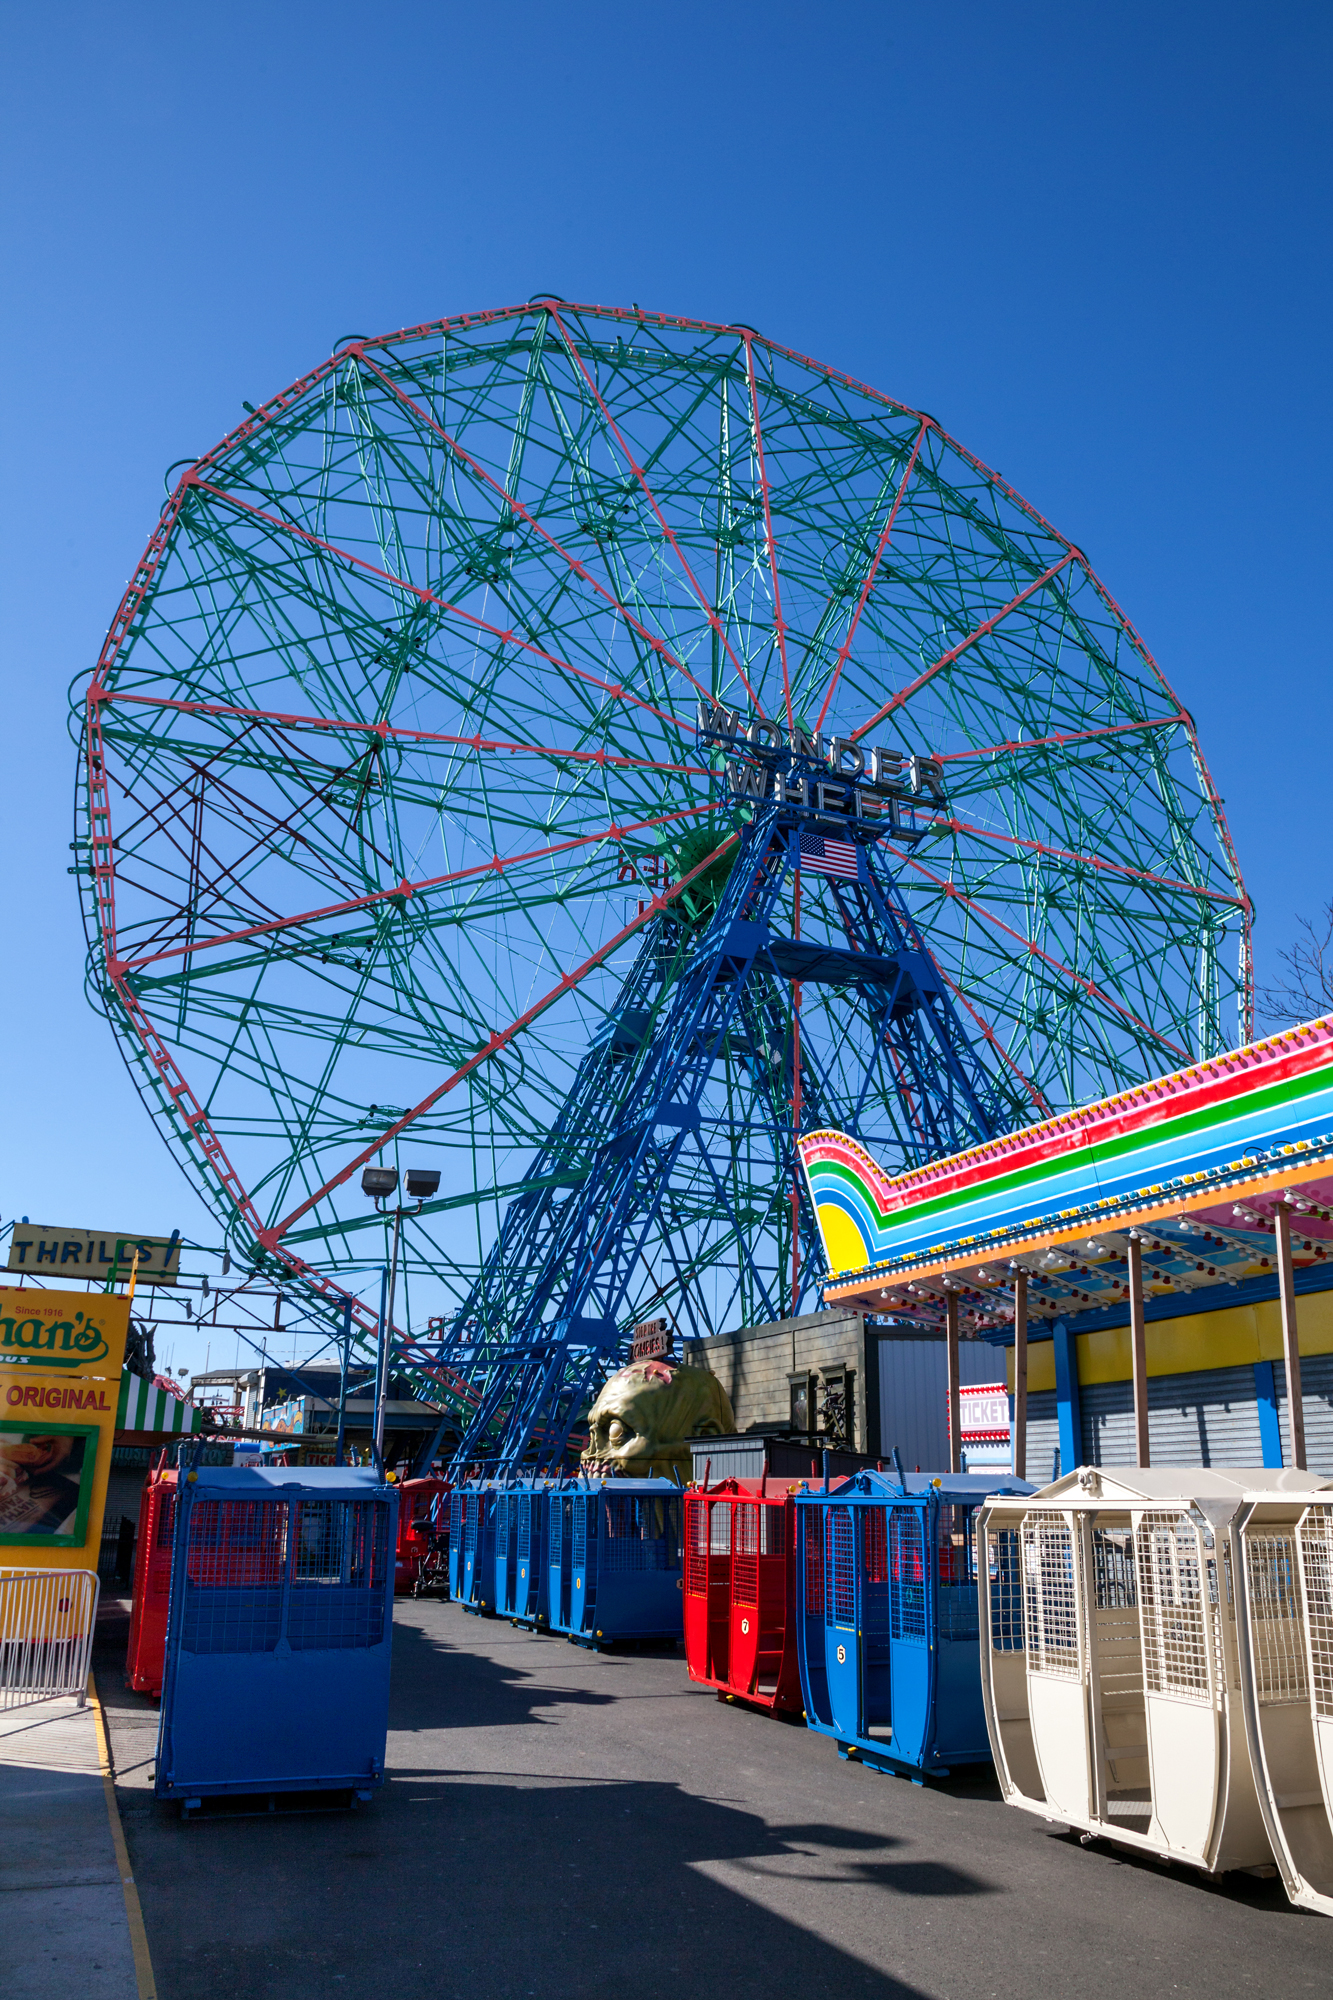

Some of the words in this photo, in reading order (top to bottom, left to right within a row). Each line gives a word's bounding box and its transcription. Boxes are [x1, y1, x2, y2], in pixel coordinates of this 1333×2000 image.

[697, 702, 947, 800] WONDER
[724, 760, 926, 842] WHEEL
[15, 1306, 41, 1316] Since
[43, 1308, 63, 1318] 1916
[6, 1385, 111, 1411] ORIGINAL
[743, 1621, 748, 1631] 7
[838, 1648, 845, 1660] 5
